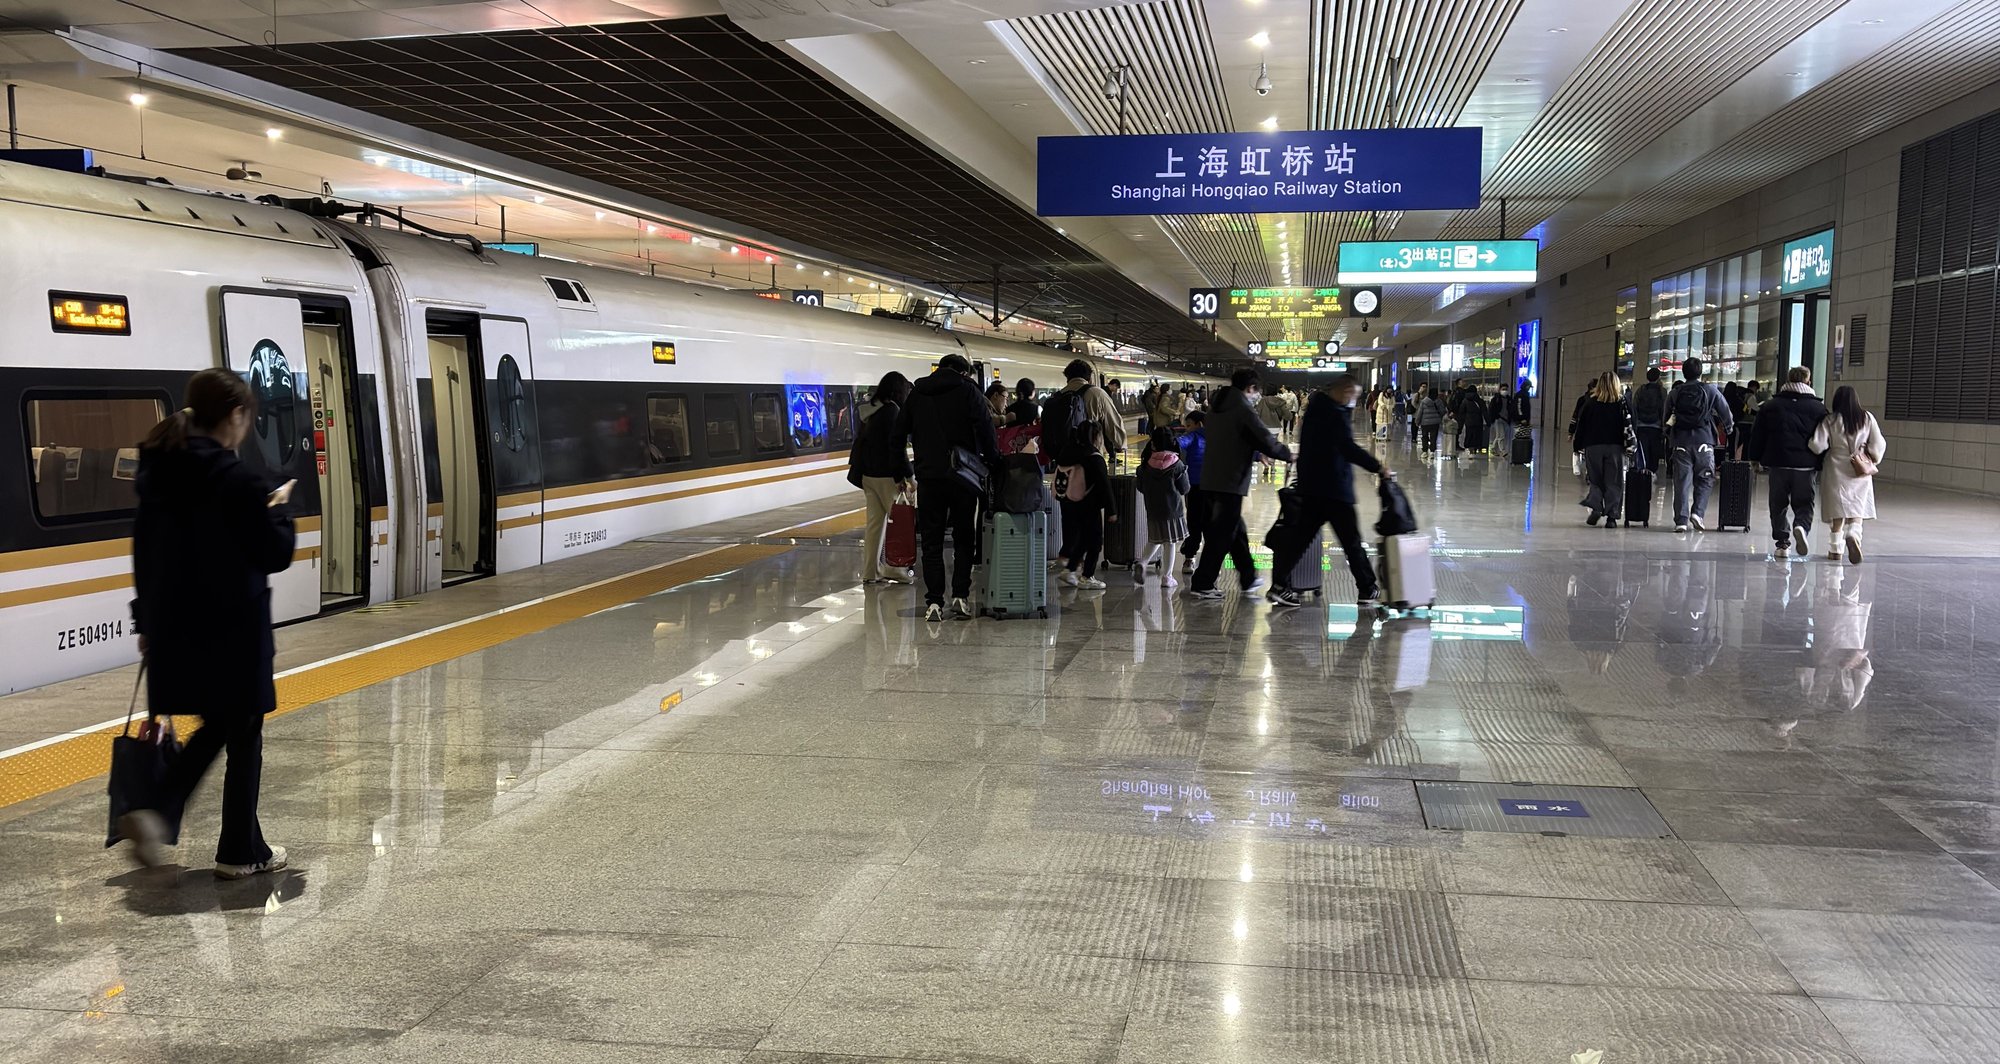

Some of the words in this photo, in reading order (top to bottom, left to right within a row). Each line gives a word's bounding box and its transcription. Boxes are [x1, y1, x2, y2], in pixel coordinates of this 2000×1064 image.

[1155, 142, 1357, 178] 上海虹桥站
[1111, 184, 1186, 201] Shanghai
[1191, 182, 1268, 200] Hongqiao
[1274, 180, 1338, 198] Railway
[1343, 180, 1402, 195] Station
[1192, 293, 1218, 314] 30
[1248, 343, 1262, 355] 30
[1266, 359, 1276, 368] 30
